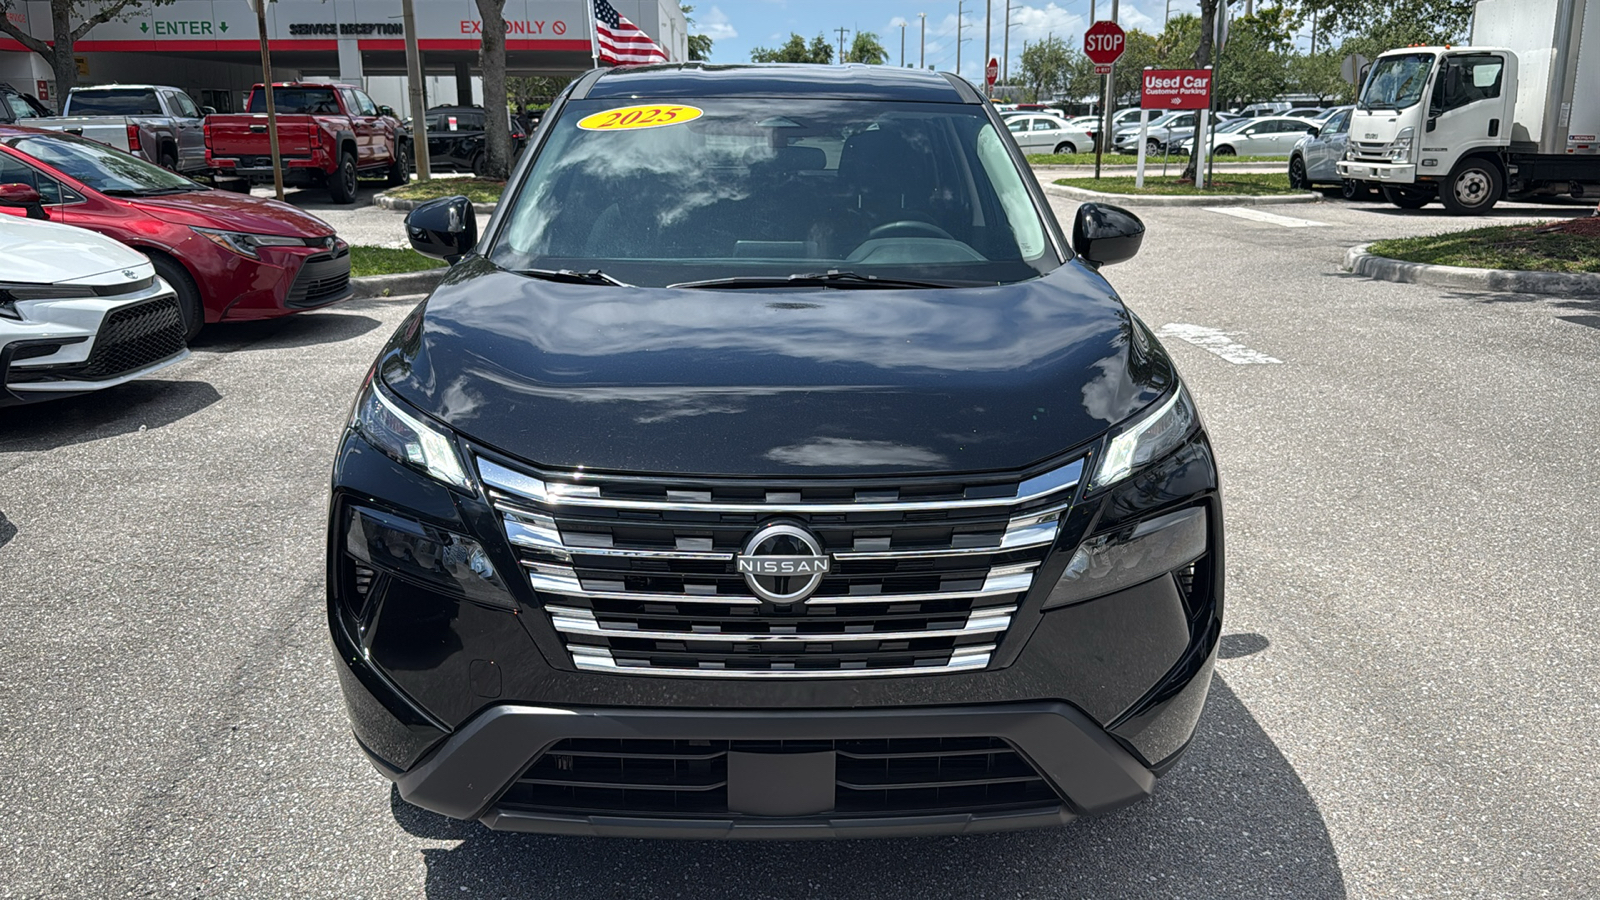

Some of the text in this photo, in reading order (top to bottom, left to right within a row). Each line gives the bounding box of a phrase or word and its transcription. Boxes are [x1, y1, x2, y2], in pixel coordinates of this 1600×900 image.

[155, 21, 213, 35] ENTER
[289, 23, 403, 35] SERVICE RECEPTION
[460, 20, 545, 34] EX ONLY
[1086, 34, 1123, 51] STOP
[1145, 76, 1208, 88] Used Car
[1179, 88, 1206, 96] Parking
[597, 108, 683, 128] 2025
[740, 560, 827, 572] NISSAN
